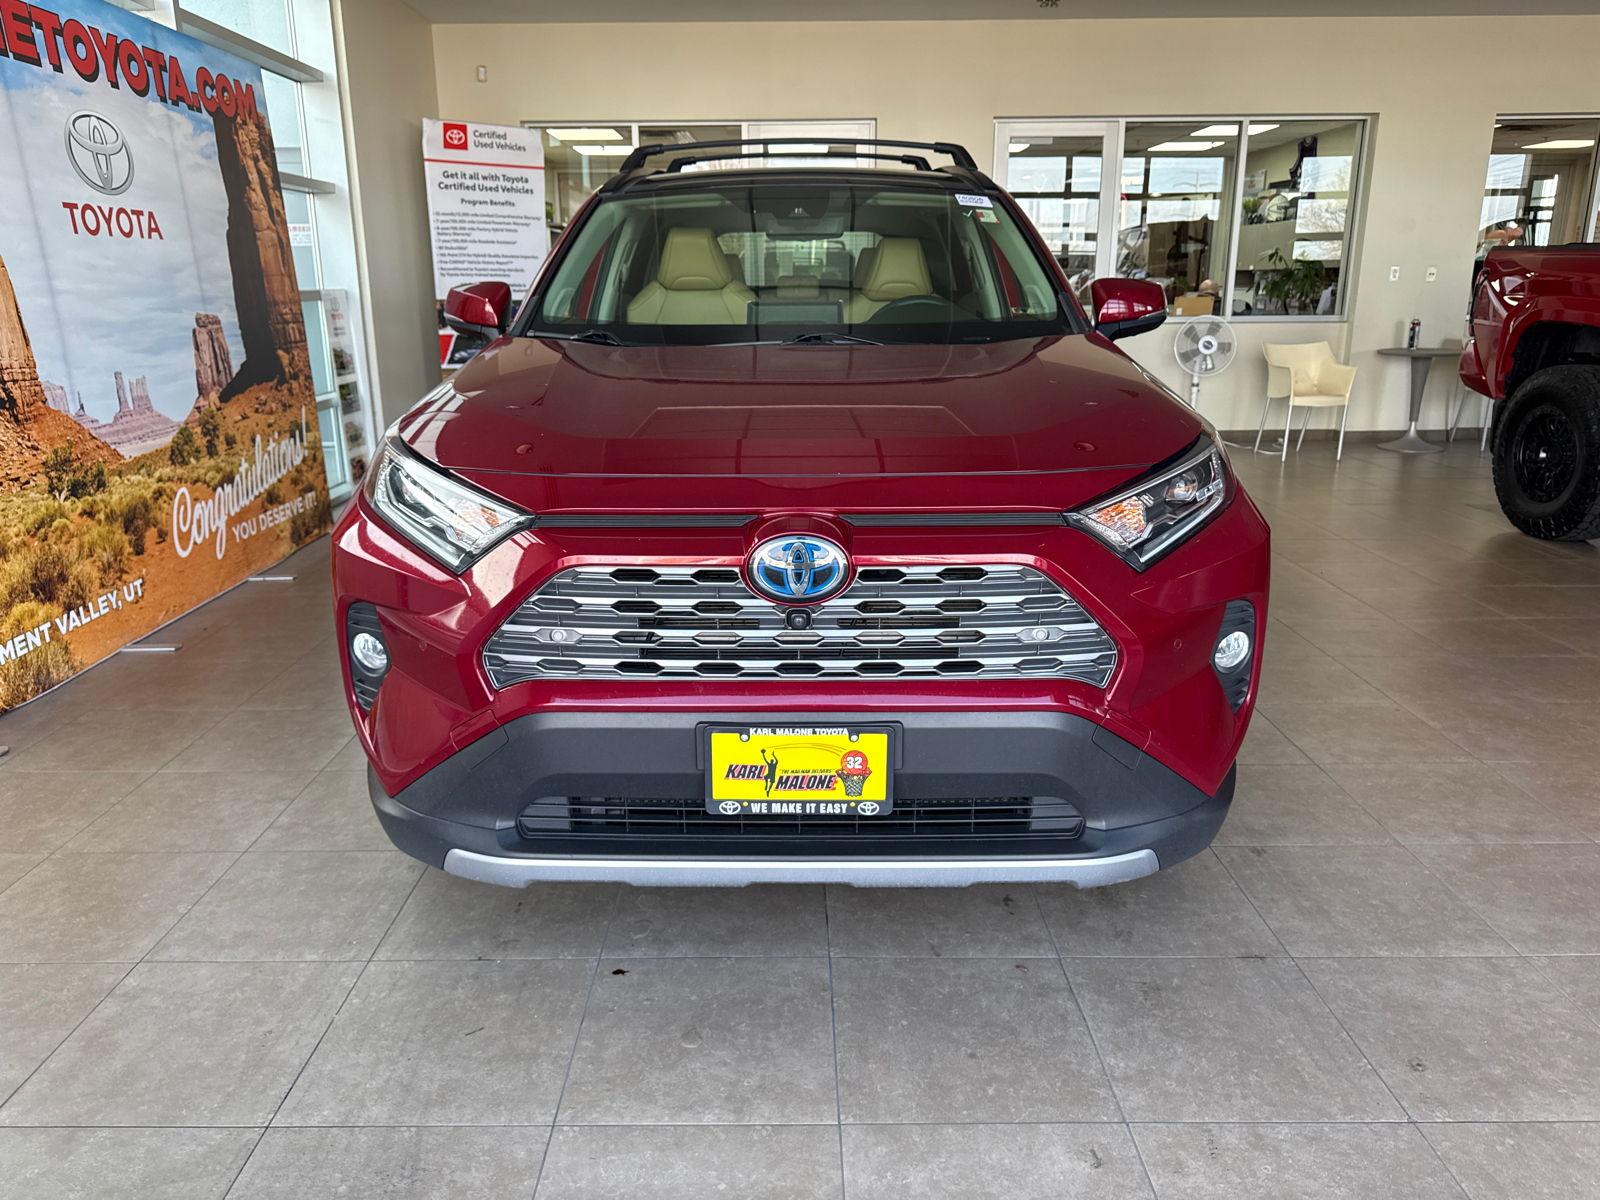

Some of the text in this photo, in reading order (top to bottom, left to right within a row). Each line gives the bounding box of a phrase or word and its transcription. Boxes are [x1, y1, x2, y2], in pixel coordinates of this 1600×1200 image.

[473, 130, 507, 140] Certified
[474, 140, 526, 152] Used Vehicles
[443, 171, 529, 185] Get it all with Toyota
[438, 181, 534, 195] Certified Used Vehicles
[461, 198, 515, 207] Program Benefits
[62, 201, 164, 240] TOYOTA
[173, 405, 308, 559] Congratulations!
[231, 491, 317, 543] YOU DESERVE IT!
[54, 590, 123, 636] VALLEY,
[122, 578, 144, 602] UT
[749, 728, 849, 736] KARL MALONE TOYOTA
[846, 756, 863, 769] 32
[724, 764, 767, 780] KARL
[774, 774, 840, 791] MALONE
[751, 803, 848, 814] WE MAKE IT EASY
